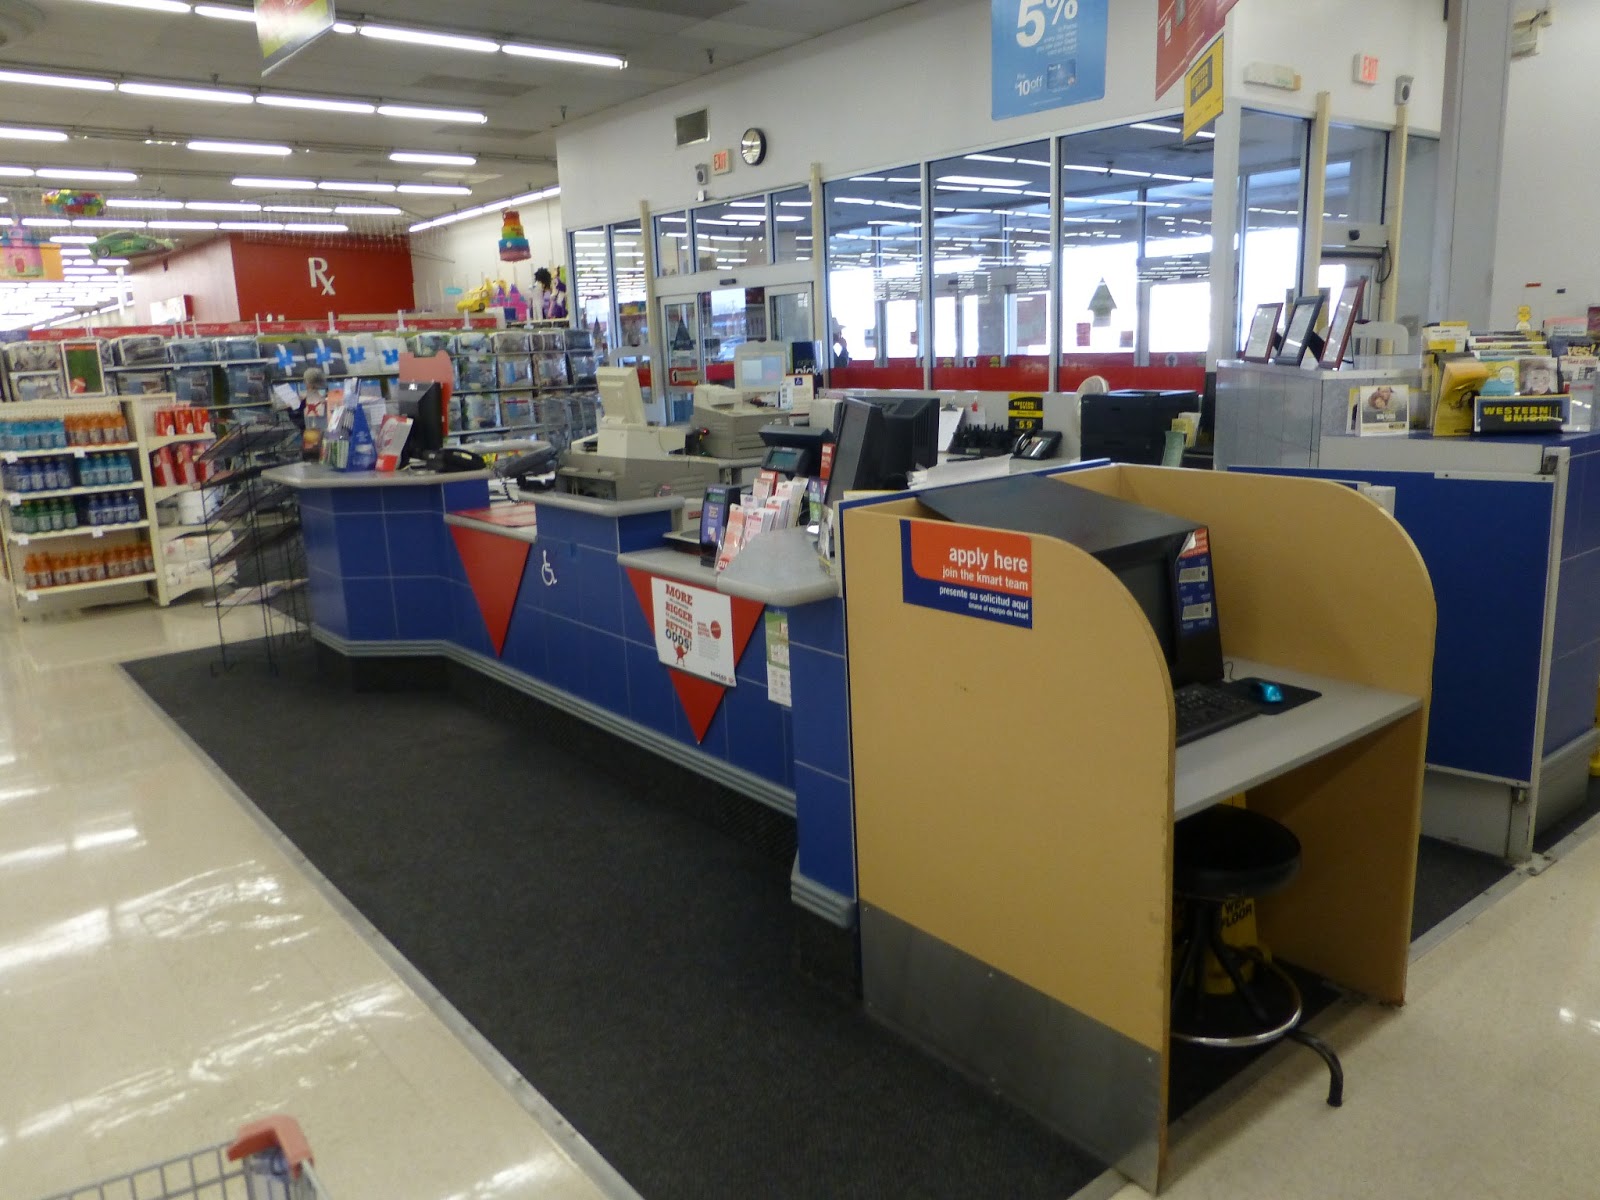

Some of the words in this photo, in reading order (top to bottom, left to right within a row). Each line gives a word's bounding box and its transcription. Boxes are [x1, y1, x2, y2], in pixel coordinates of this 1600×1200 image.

[1483, 406, 1549, 415] WESTERN
[1504, 414, 1549, 422] UNION
[949, 547, 988, 570] apply
[994, 550, 1028, 573] here
[942, 566, 958, 579] join
[960, 569, 974, 581] the
[976, 572, 1003, 587] kmart
[1005, 576, 1028, 591] team
[665, 583, 693, 606] MORE
[939, 586, 968, 599] presente
[969, 592, 978, 600] su
[979, 593, 1010, 607] solicitud
[665, 601, 693, 623] BIGGER
[665, 619, 692, 640] BETTER
[665, 628, 692, 651] ODDS!
